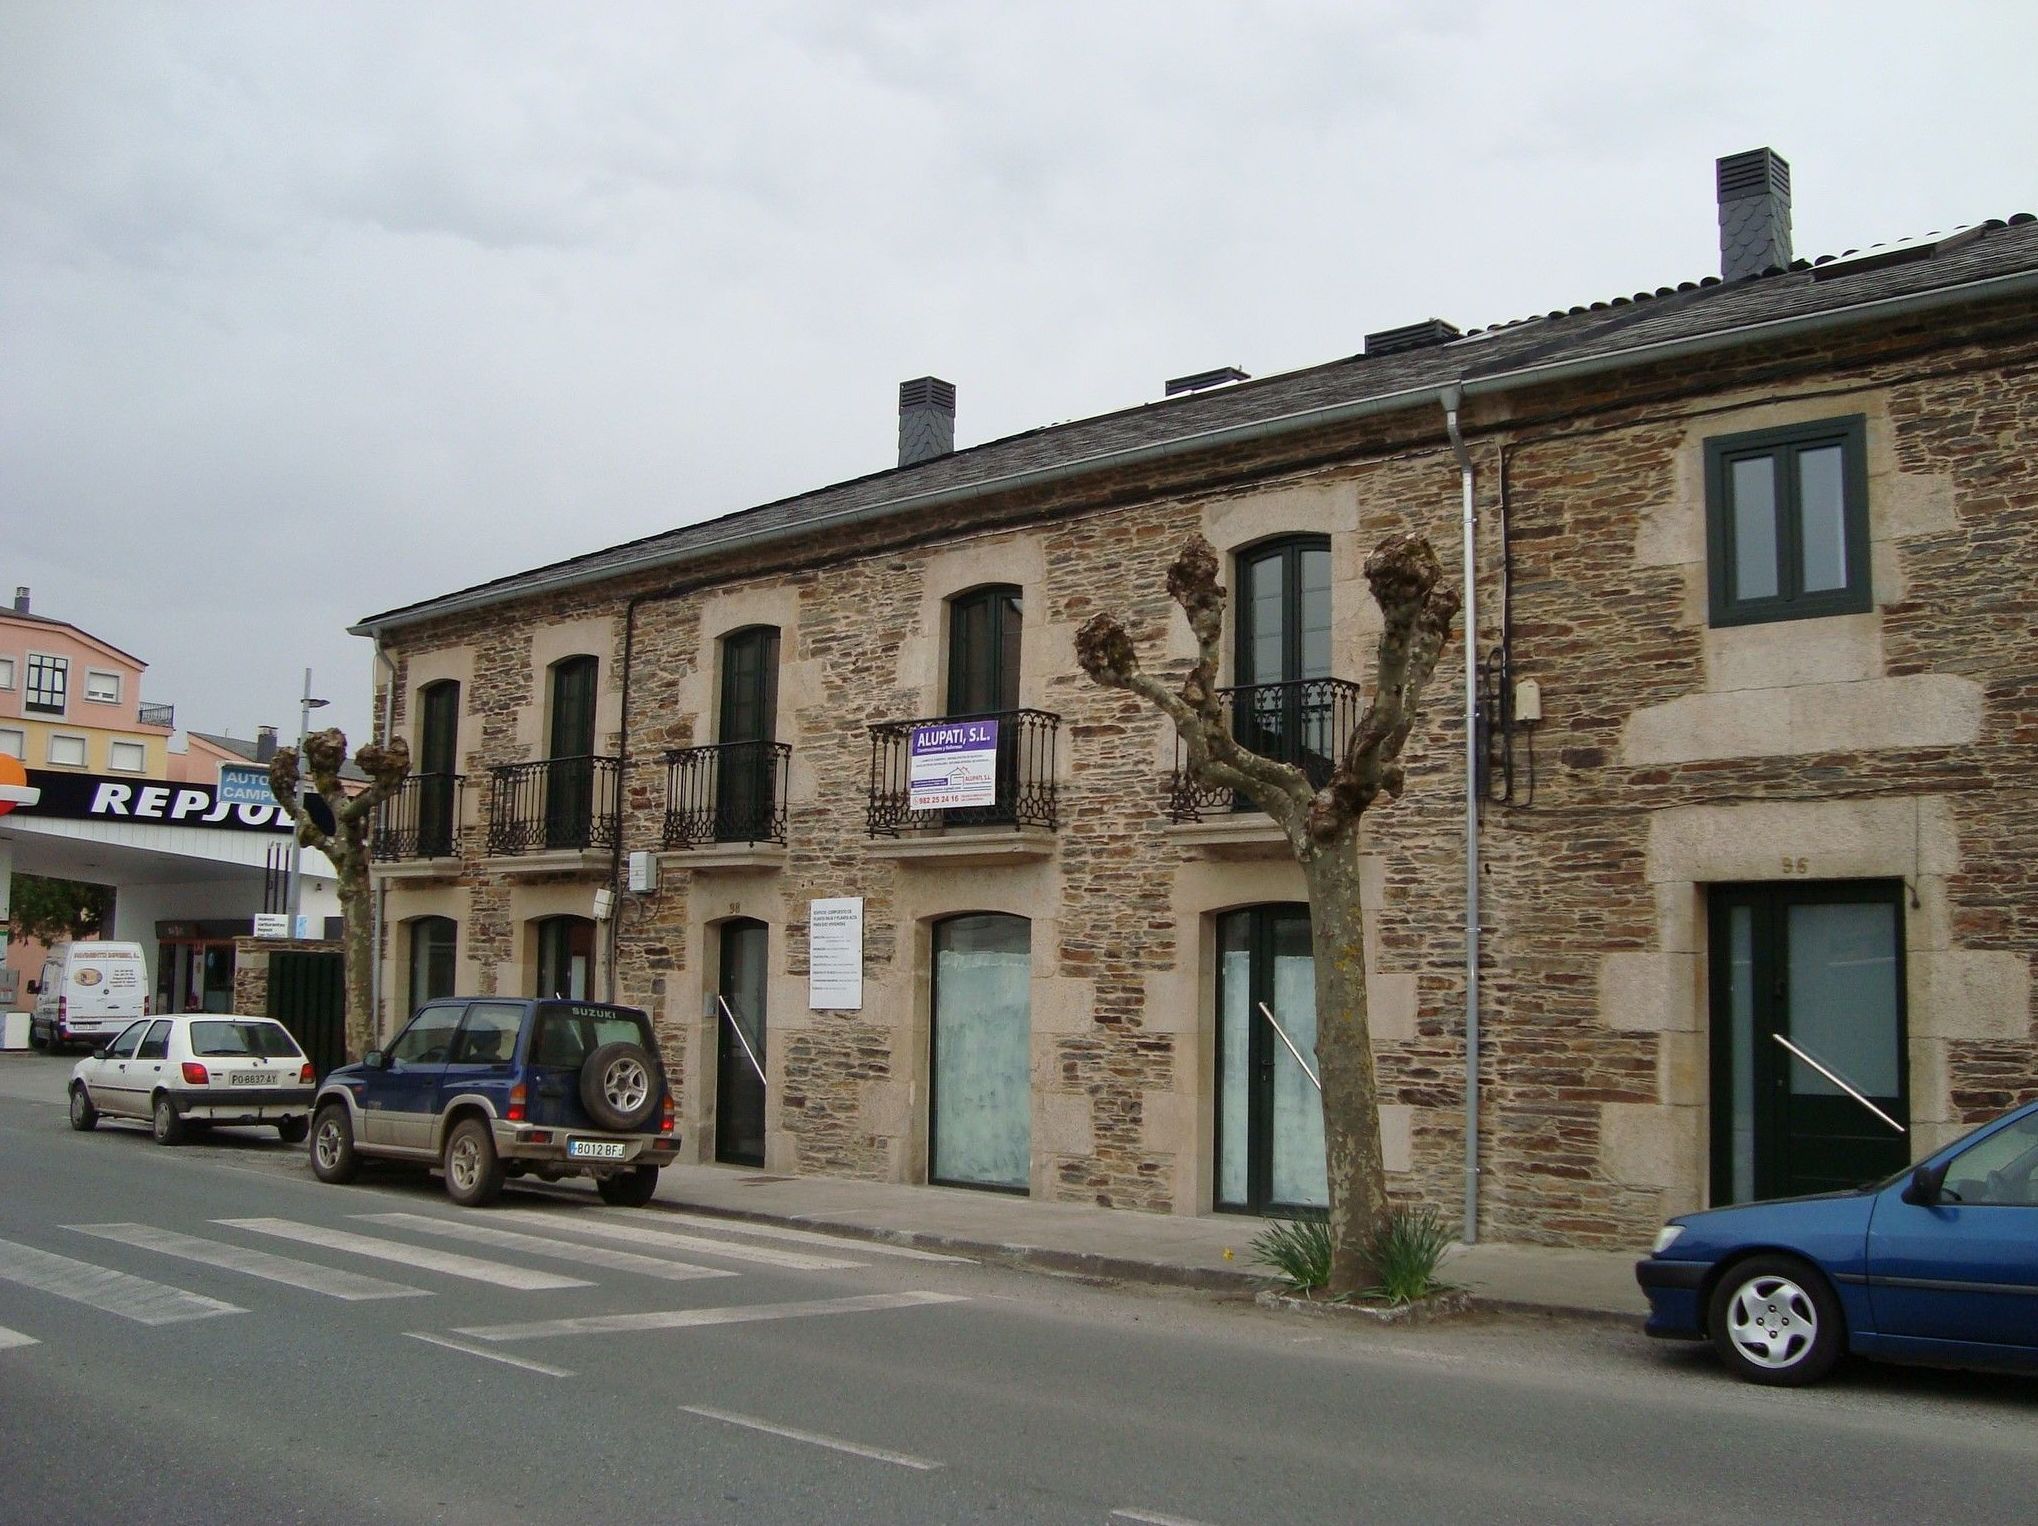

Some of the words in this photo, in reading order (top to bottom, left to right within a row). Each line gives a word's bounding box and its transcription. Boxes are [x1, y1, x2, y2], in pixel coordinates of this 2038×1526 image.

[917, 729, 966, 745] ALUPATI,
[969, 727, 990, 742] S.L.
[226, 771, 270, 786] AUTO
[572, 1007, 616, 1019] SUZUKI
[577, 1143, 603, 1155] 8012
[605, 1145, 625, 1156] BFJ
